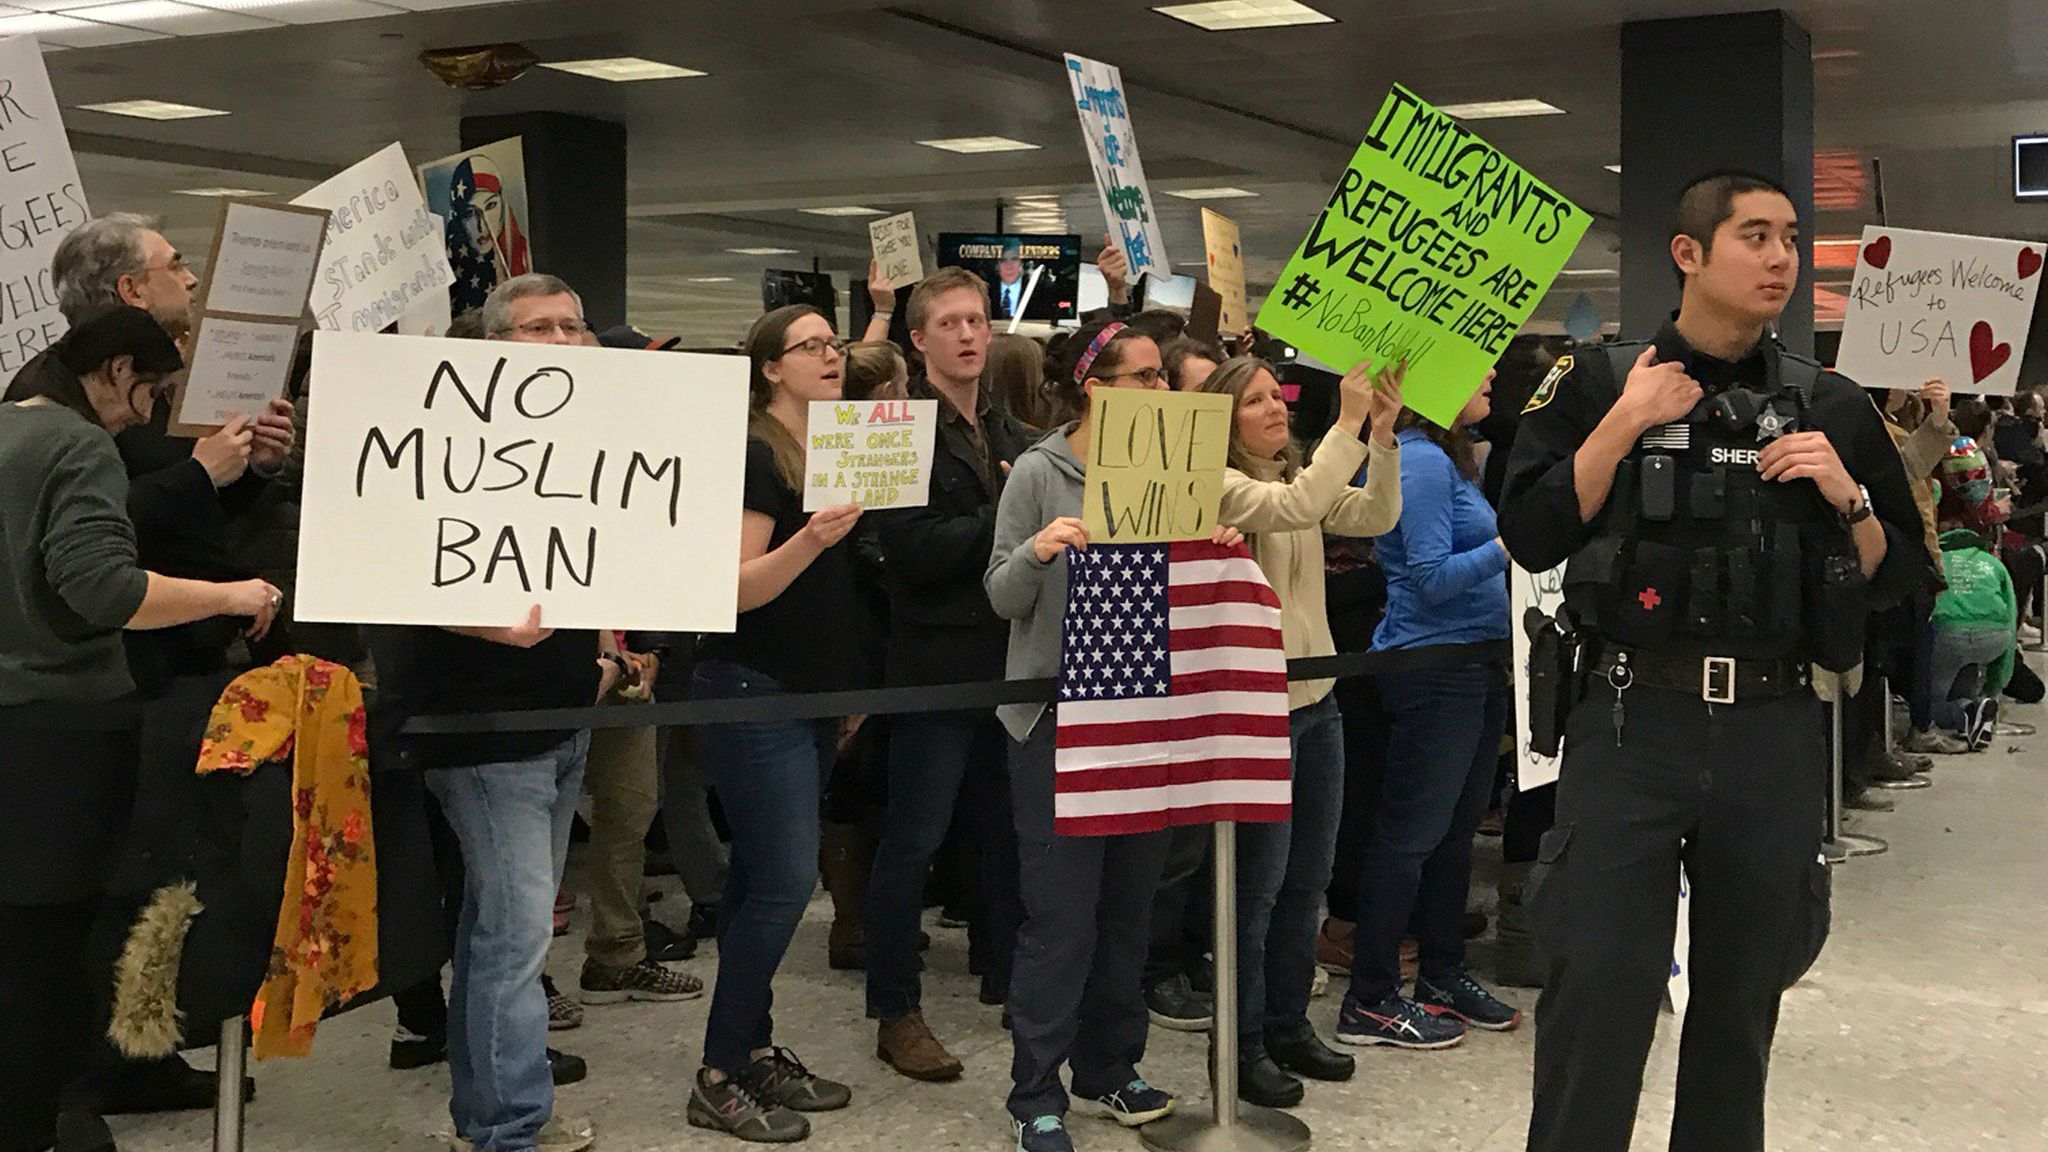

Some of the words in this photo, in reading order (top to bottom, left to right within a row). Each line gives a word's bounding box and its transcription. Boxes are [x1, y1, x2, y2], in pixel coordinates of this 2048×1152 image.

[1364, 85, 1572, 244] IMMIGRANTS
[325, 180, 399, 245] merica
[1441, 200, 1490, 236] AND
[959, 244, 1004, 259] COMPANY
[1327, 168, 1488, 278] REFUGEES
[1480, 263, 1538, 309] ARE
[1302, 210, 1467, 325] WELCOME
[1449, 301, 1519, 355] HERE
[1952, 256, 2024, 301] Welcome
[1927, 294, 1946, 310] to
[1879, 318, 1957, 357] USA
[424, 357, 574, 423] NO
[867, 402, 915, 425] ALL
[812, 432, 854, 449] WERE
[866, 429, 913, 449] ONCE
[1097, 400, 1225, 473] LOVE
[1711, 447, 1759, 464] SHER
[356, 426, 681, 526] MUSLIM
[812, 472, 828, 487] IN
[834, 471, 847, 488] A
[851, 468, 919, 489] STRANGE
[836, 451, 919, 468] STRANGERS
[851, 488, 900, 507] LAND
[1102, 477, 1206, 538] WINS
[431, 517, 597, 592] BAN
